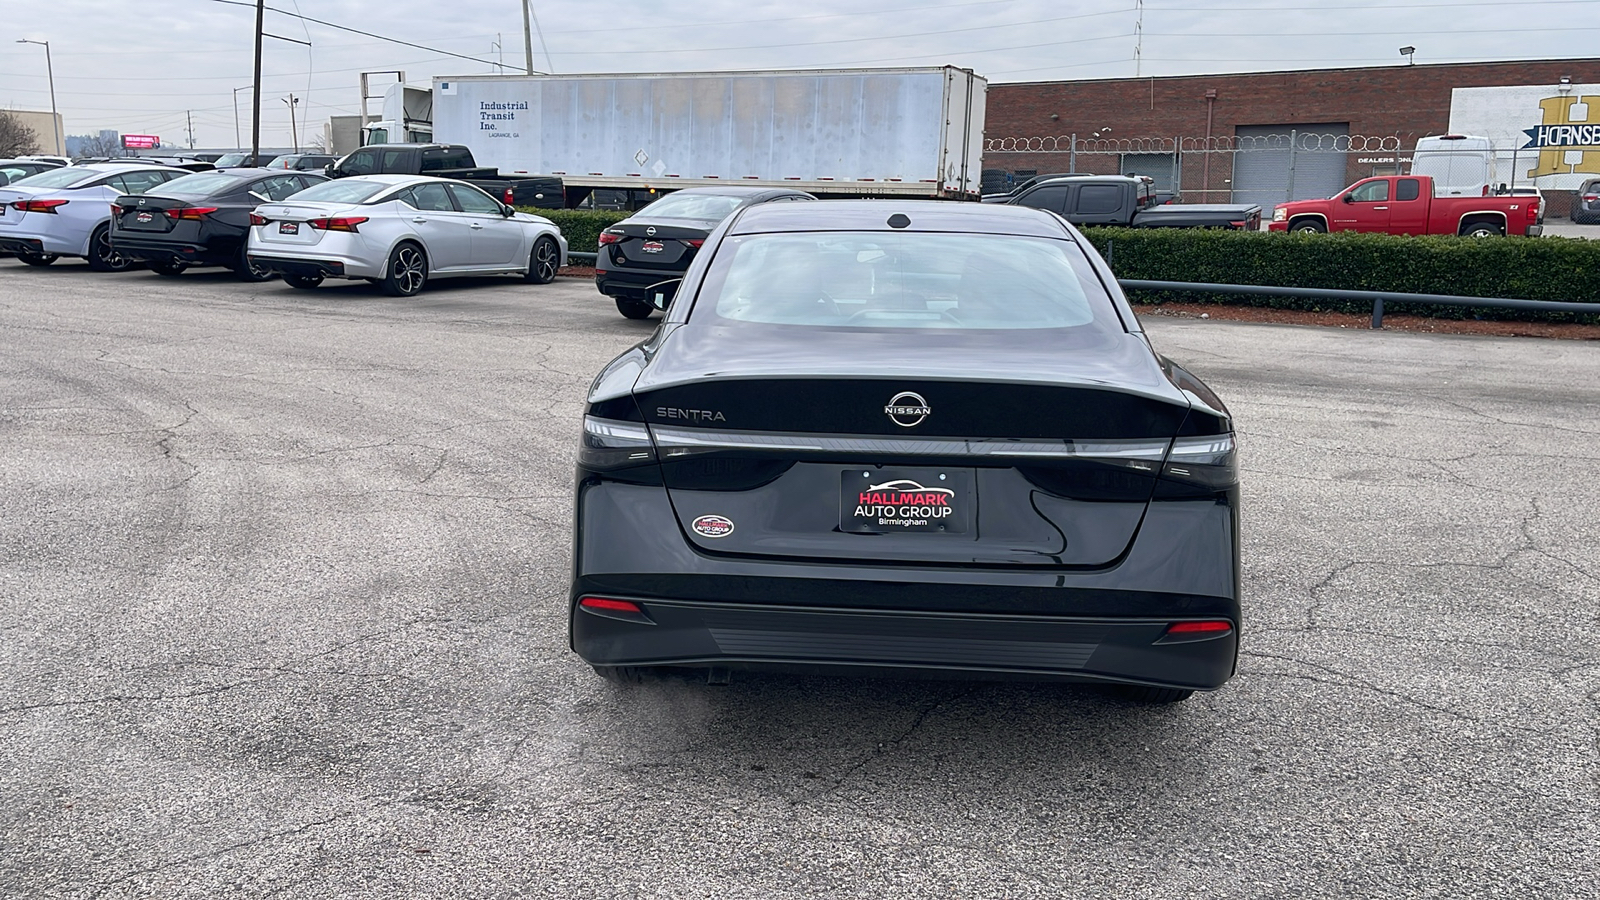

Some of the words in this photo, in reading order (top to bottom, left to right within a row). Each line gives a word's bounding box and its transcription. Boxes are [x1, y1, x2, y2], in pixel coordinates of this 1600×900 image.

[480, 101, 528, 110] Industrial
[480, 112, 515, 120] Transit
[480, 122, 497, 130] Inc.
[656, 406, 726, 421] SENTRA
[860, 493, 948, 505] HALLMARK
[854, 506, 895, 517] AUTO
[900, 506, 952, 518] GROUP
[879, 518, 927, 527] Birmingham
